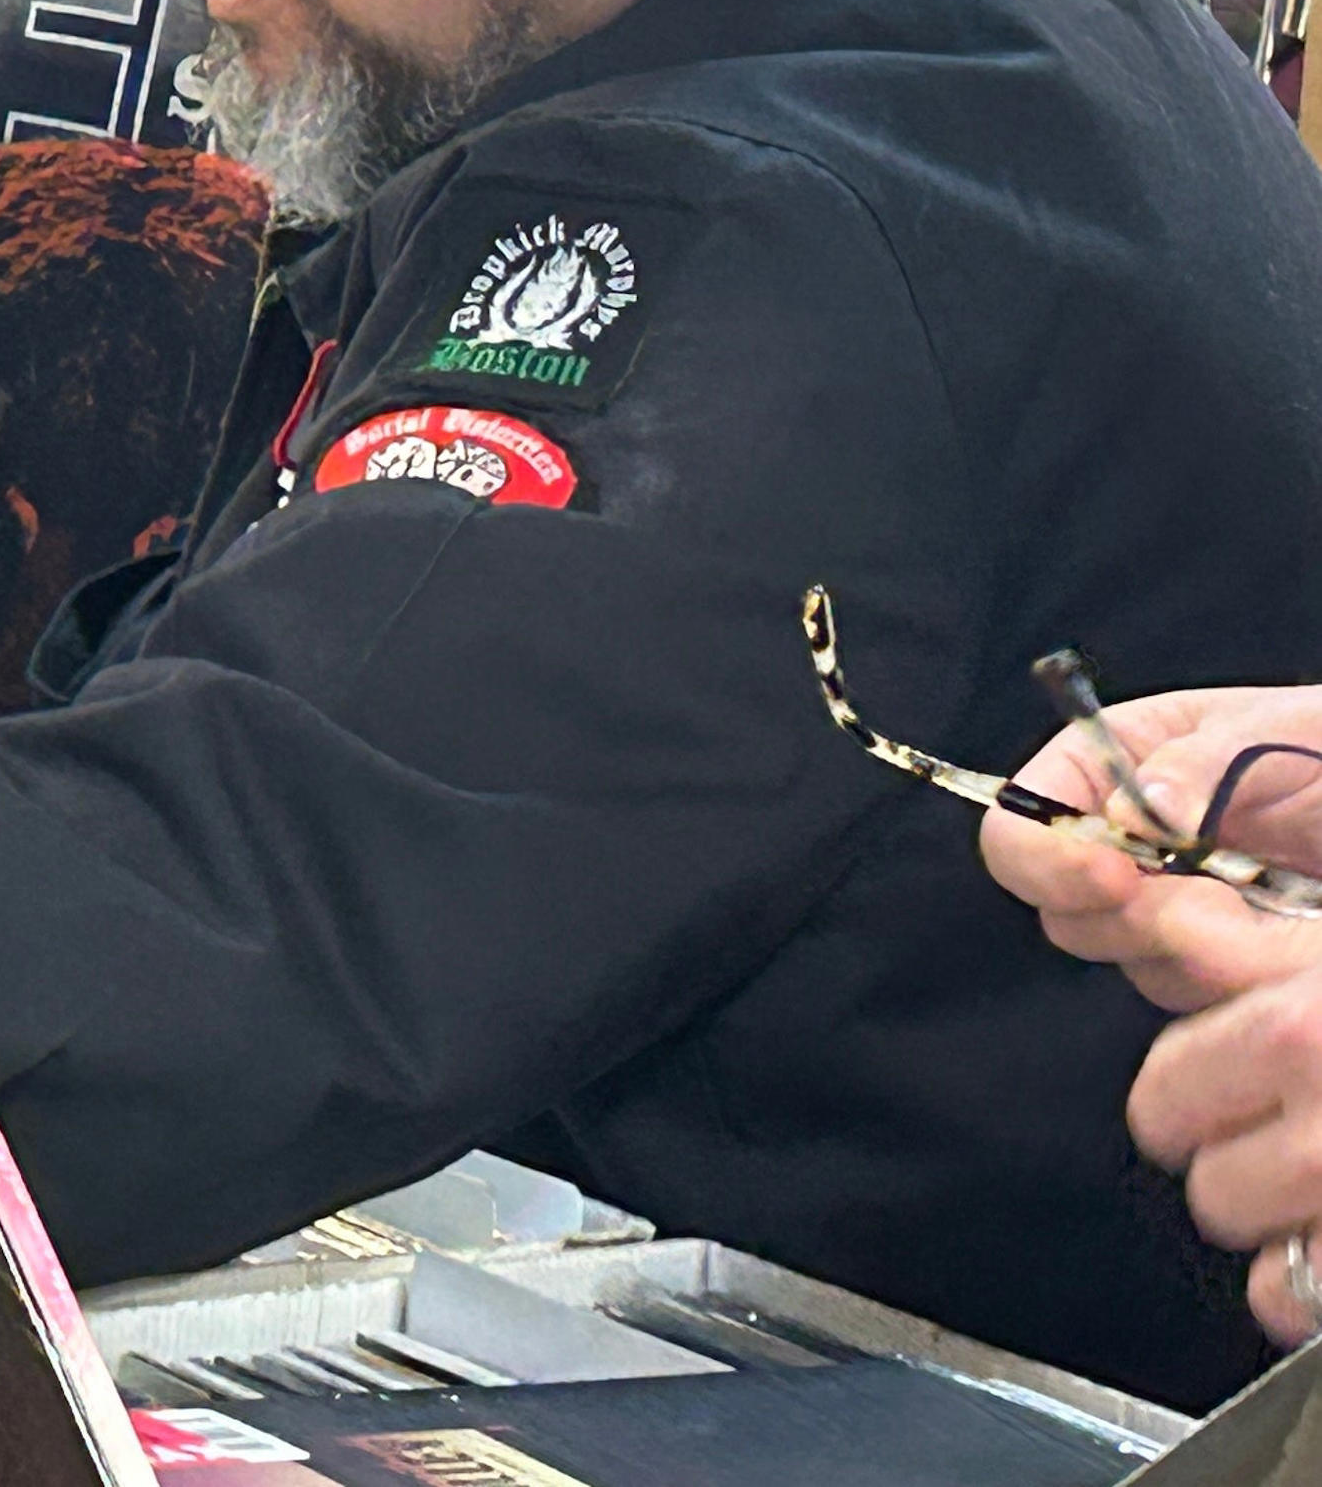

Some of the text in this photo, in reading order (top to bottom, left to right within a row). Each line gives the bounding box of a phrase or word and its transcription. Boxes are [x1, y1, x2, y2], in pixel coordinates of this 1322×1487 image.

[449, 214, 638, 342] Dropkick Murphys
[430, 336, 591, 386] Boston
